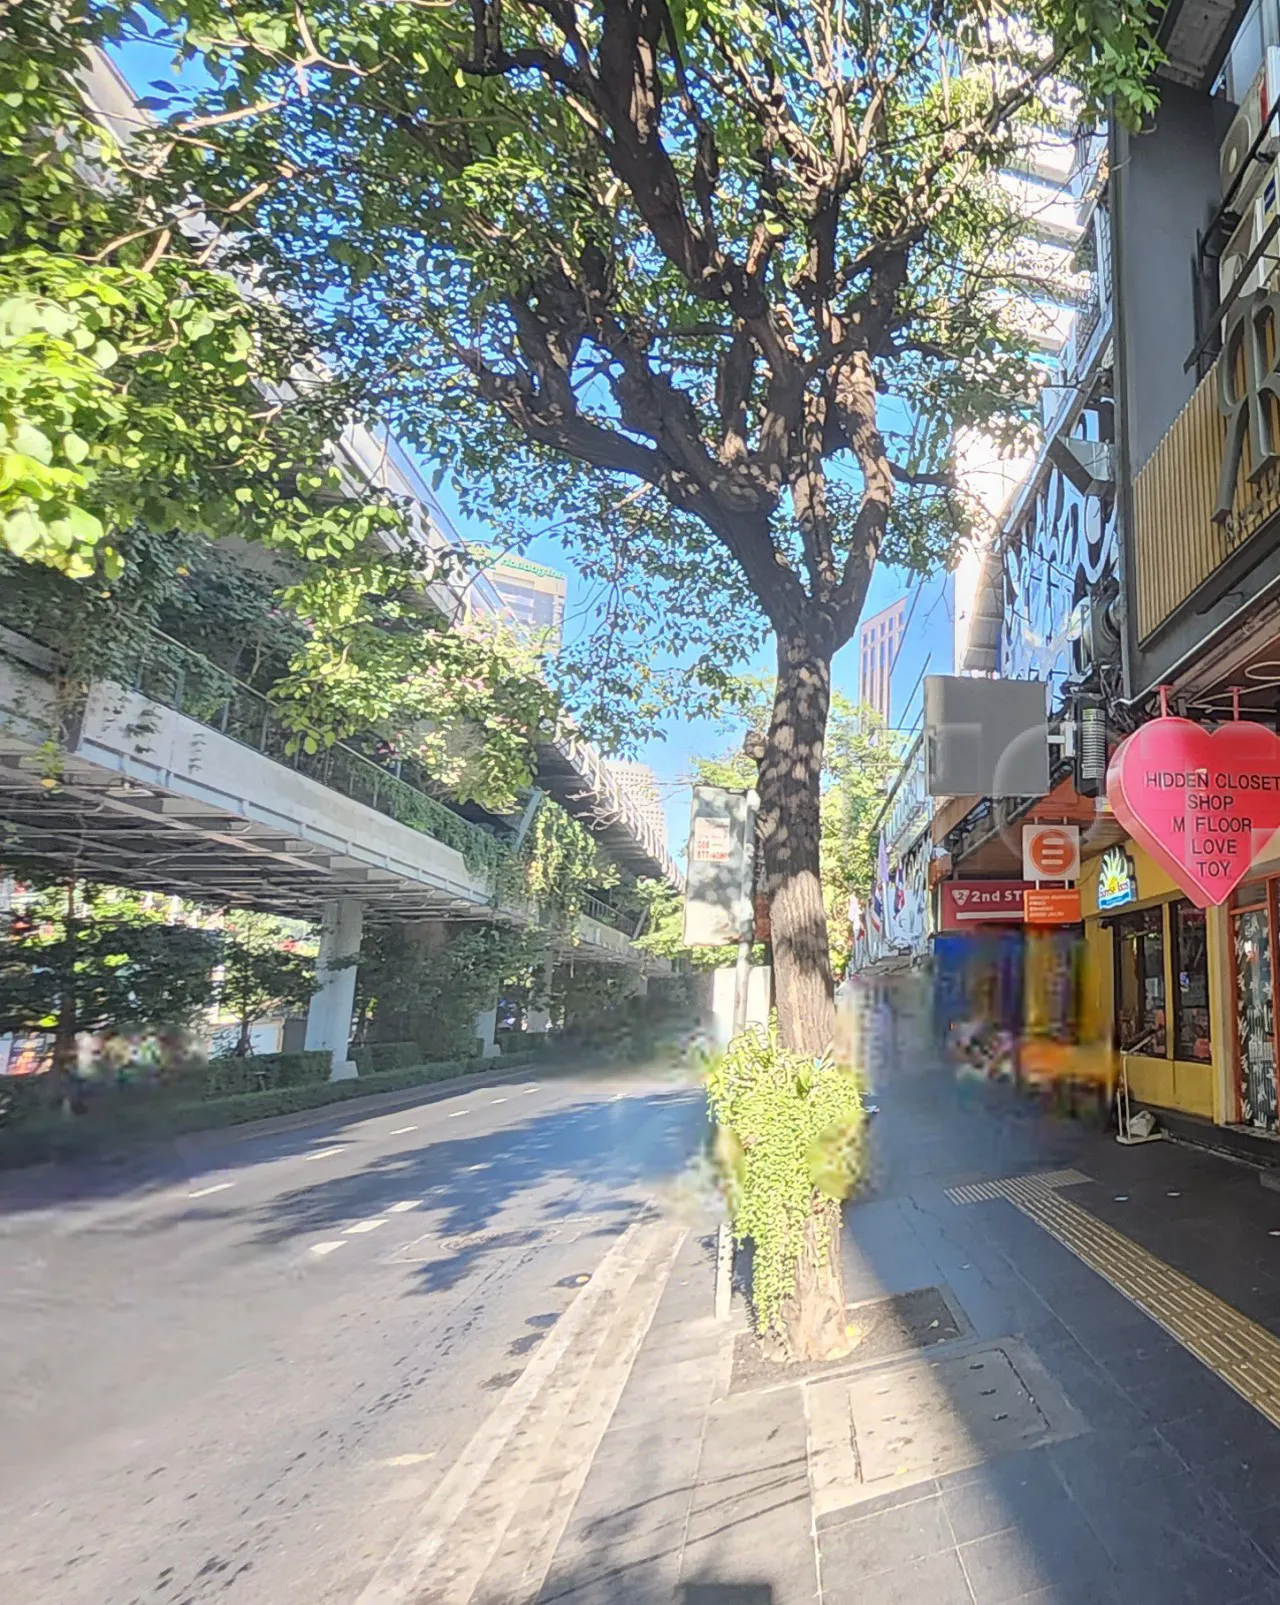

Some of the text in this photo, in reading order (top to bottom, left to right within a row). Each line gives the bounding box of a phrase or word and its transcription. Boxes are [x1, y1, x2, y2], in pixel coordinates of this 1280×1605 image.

[1146, 771, 1209, 788] HIDDEN
[1188, 794, 1234, 811] SHOP
[1173, 816, 1252, 833] M FLOOR
[1191, 839, 1237, 855] LOVE
[1196, 861, 1231, 877] TOY
[971, 890, 1000, 902] 2nd
